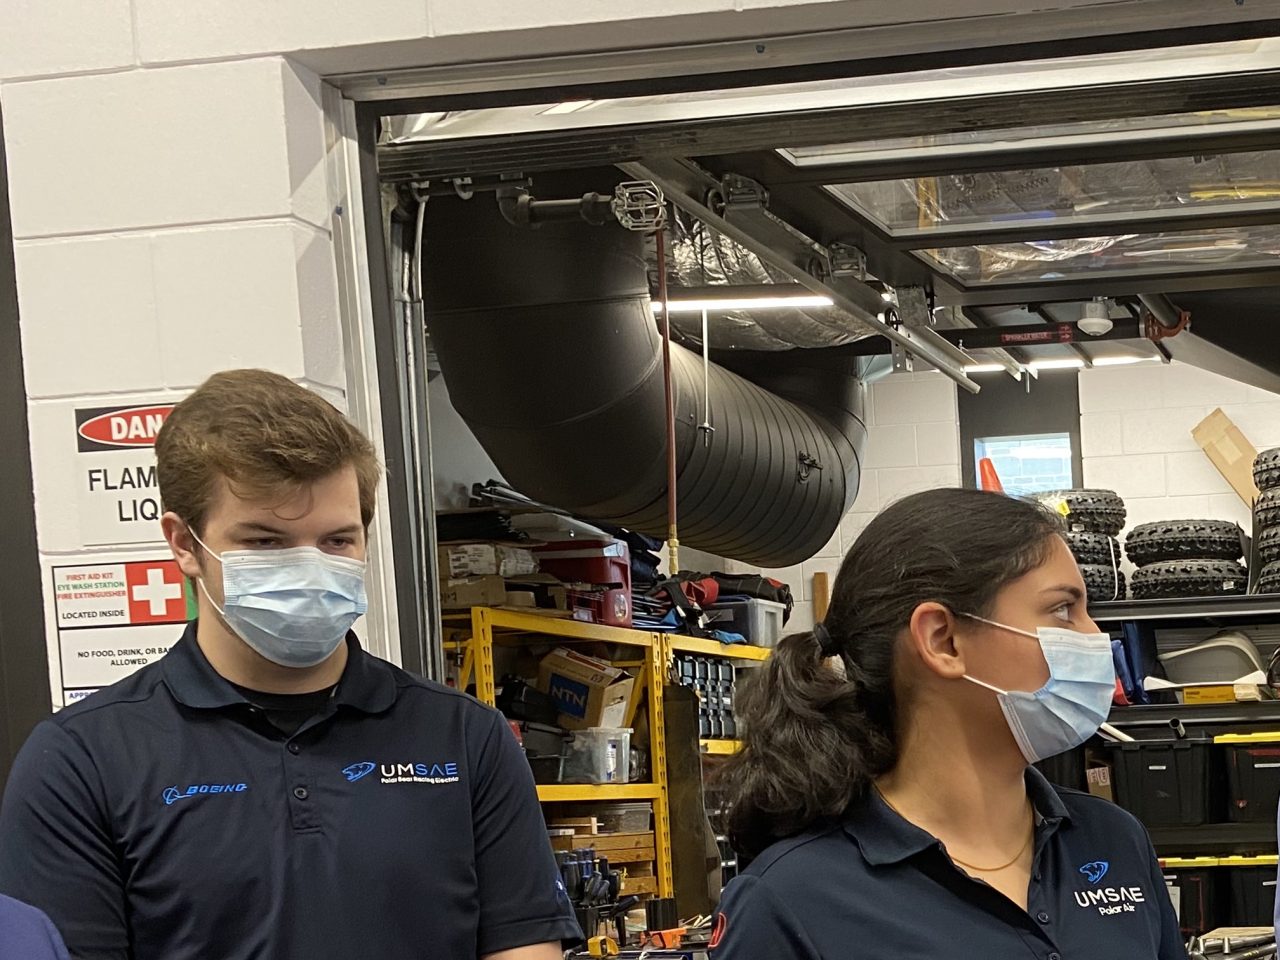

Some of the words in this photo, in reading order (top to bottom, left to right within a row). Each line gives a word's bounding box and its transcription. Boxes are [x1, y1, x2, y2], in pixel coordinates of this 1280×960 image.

[110, 414, 164, 440] DAN
[88, 465, 158, 491] FLAM
[118, 498, 160, 522] LIQ
[66, 573, 86, 581] FIRST
[94, 581, 124, 589] STATION
[62, 611, 99, 619] LOCATED
[91, 650, 116, 658] FOOD,
[551, 685, 586, 707] NTN
[186, 783, 247, 794] BOEING
[1098, 904, 1122, 916] Polar
[1123, 903, 1136, 912] Air
